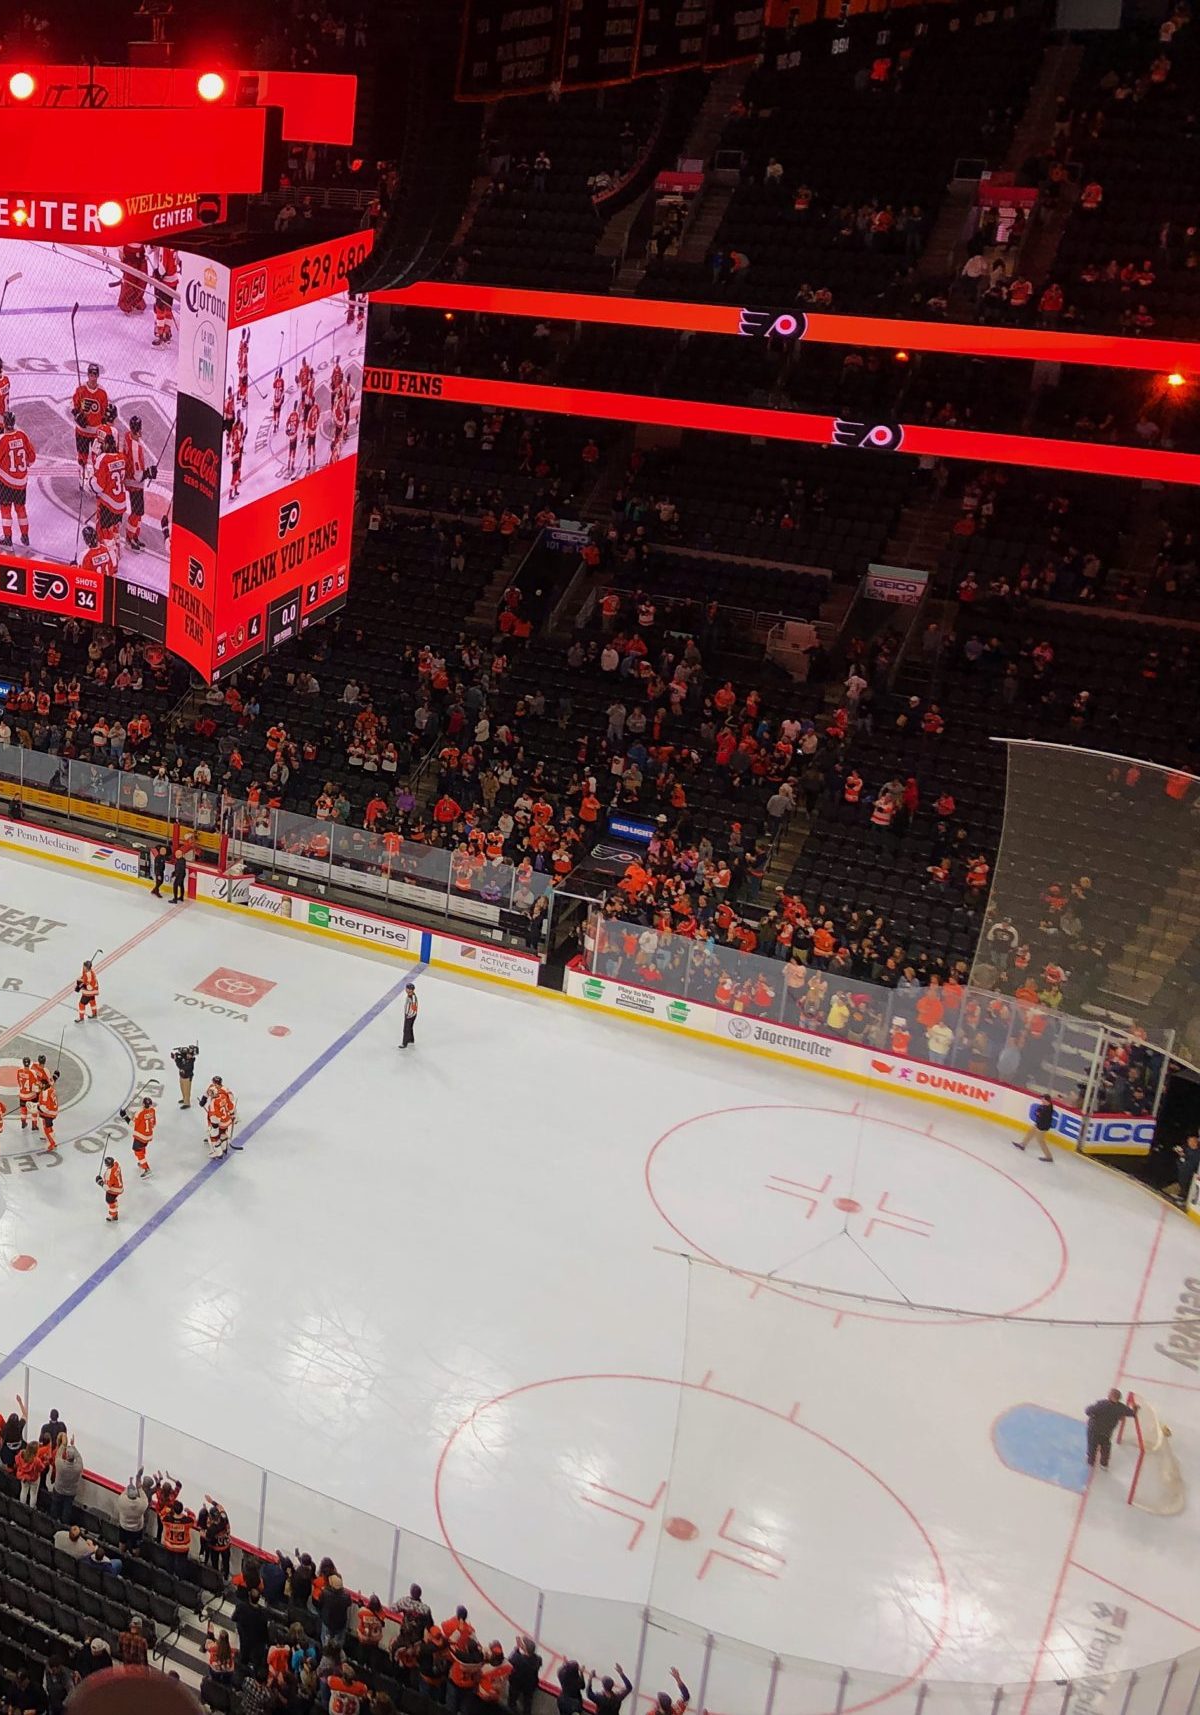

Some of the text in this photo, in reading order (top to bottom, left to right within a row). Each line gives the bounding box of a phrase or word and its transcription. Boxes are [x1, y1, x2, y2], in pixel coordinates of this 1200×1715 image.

[152, 207, 193, 230] CENTER
[185, 278, 227, 323] Corona
[395, 373, 443, 397] FANS
[8, 448, 27, 473] 13
[178, 436, 219, 487] Coca-Cola
[232, 519, 339, 600] THANK YOU FANS
[5, 569, 19, 592] 2
[75, 576, 98, 589] SHOTS
[873, 579, 917, 593] GEICO
[76, 591, 95, 609] 34
[137, 586, 160, 605] PENALTY
[172, 582, 201, 621] THANK
[308, 585, 317, 603] 2
[281, 604, 297, 626] 0.0
[184, 612, 205, 647] FANS
[250, 618, 259, 636] 4
[16, 827, 80, 854] Penn Medicine
[309, 907, 407, 943] enterprise
[479, 963, 497, 975] Credit
[480, 956, 534, 976] ACTIVE CASH
[617, 985, 632, 997] Play
[173, 992, 249, 1023] TOYOTA
[98, 1003, 165, 1072] WELLS
[915, 1071, 996, 1103] DUNKIN'
